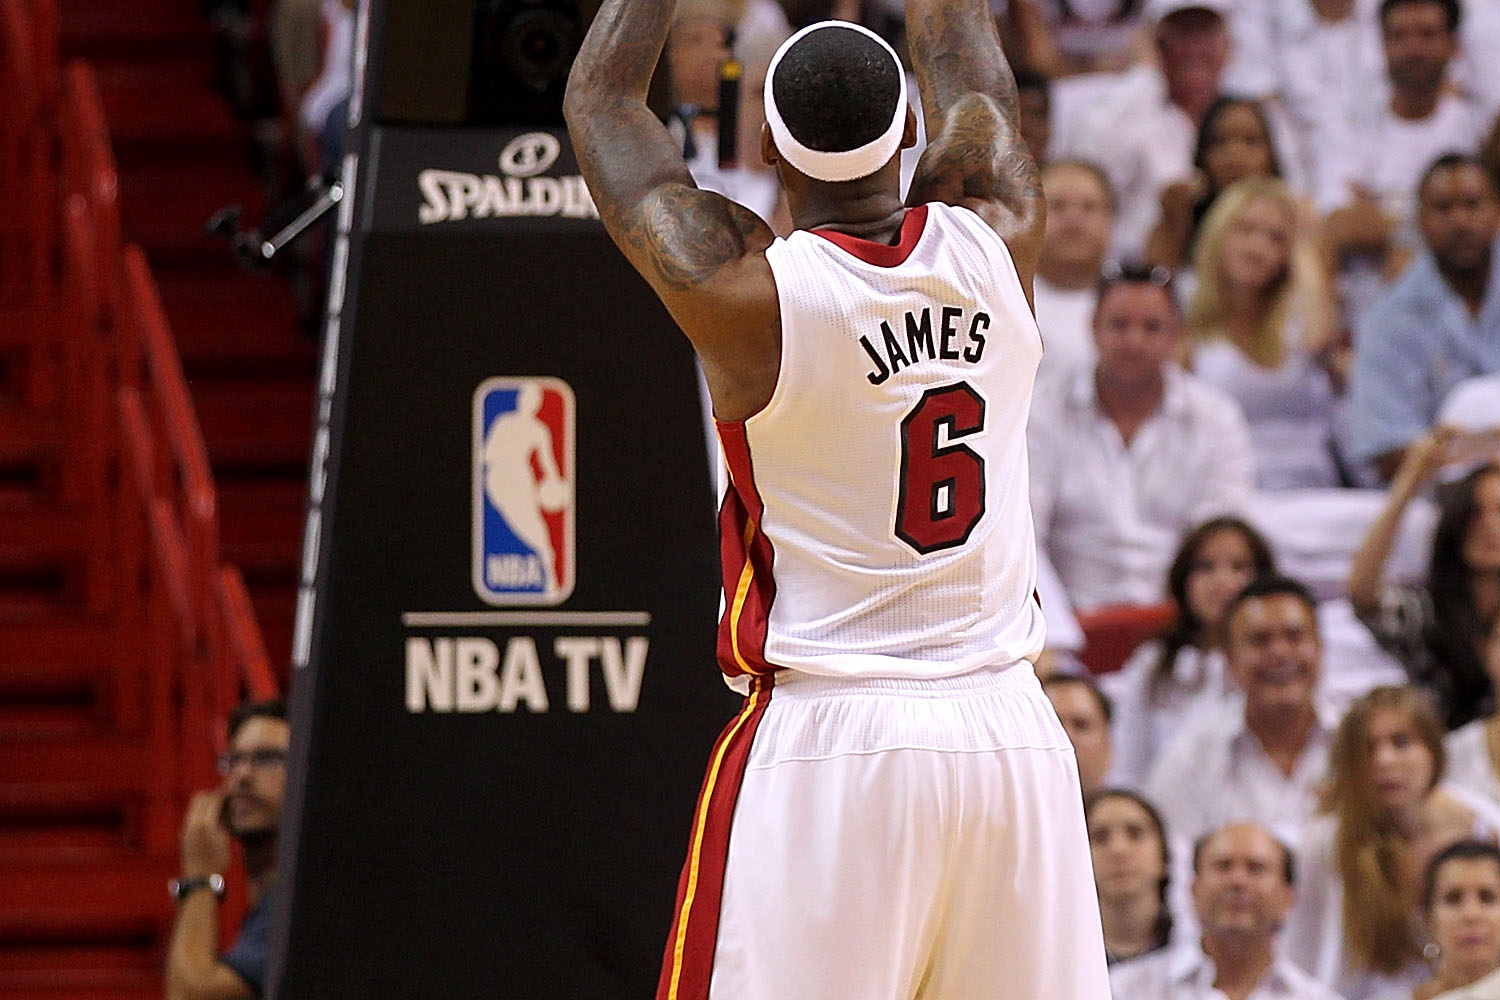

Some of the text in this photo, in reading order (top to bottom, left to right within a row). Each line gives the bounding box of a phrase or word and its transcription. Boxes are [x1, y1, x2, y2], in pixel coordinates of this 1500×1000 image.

[418, 168, 601, 225] SPALDI
[858, 306, 991, 386] JAMES
[893, 380, 986, 556] 6
[487, 553, 543, 587] NBA
[404, 636, 650, 714] NBA TV
